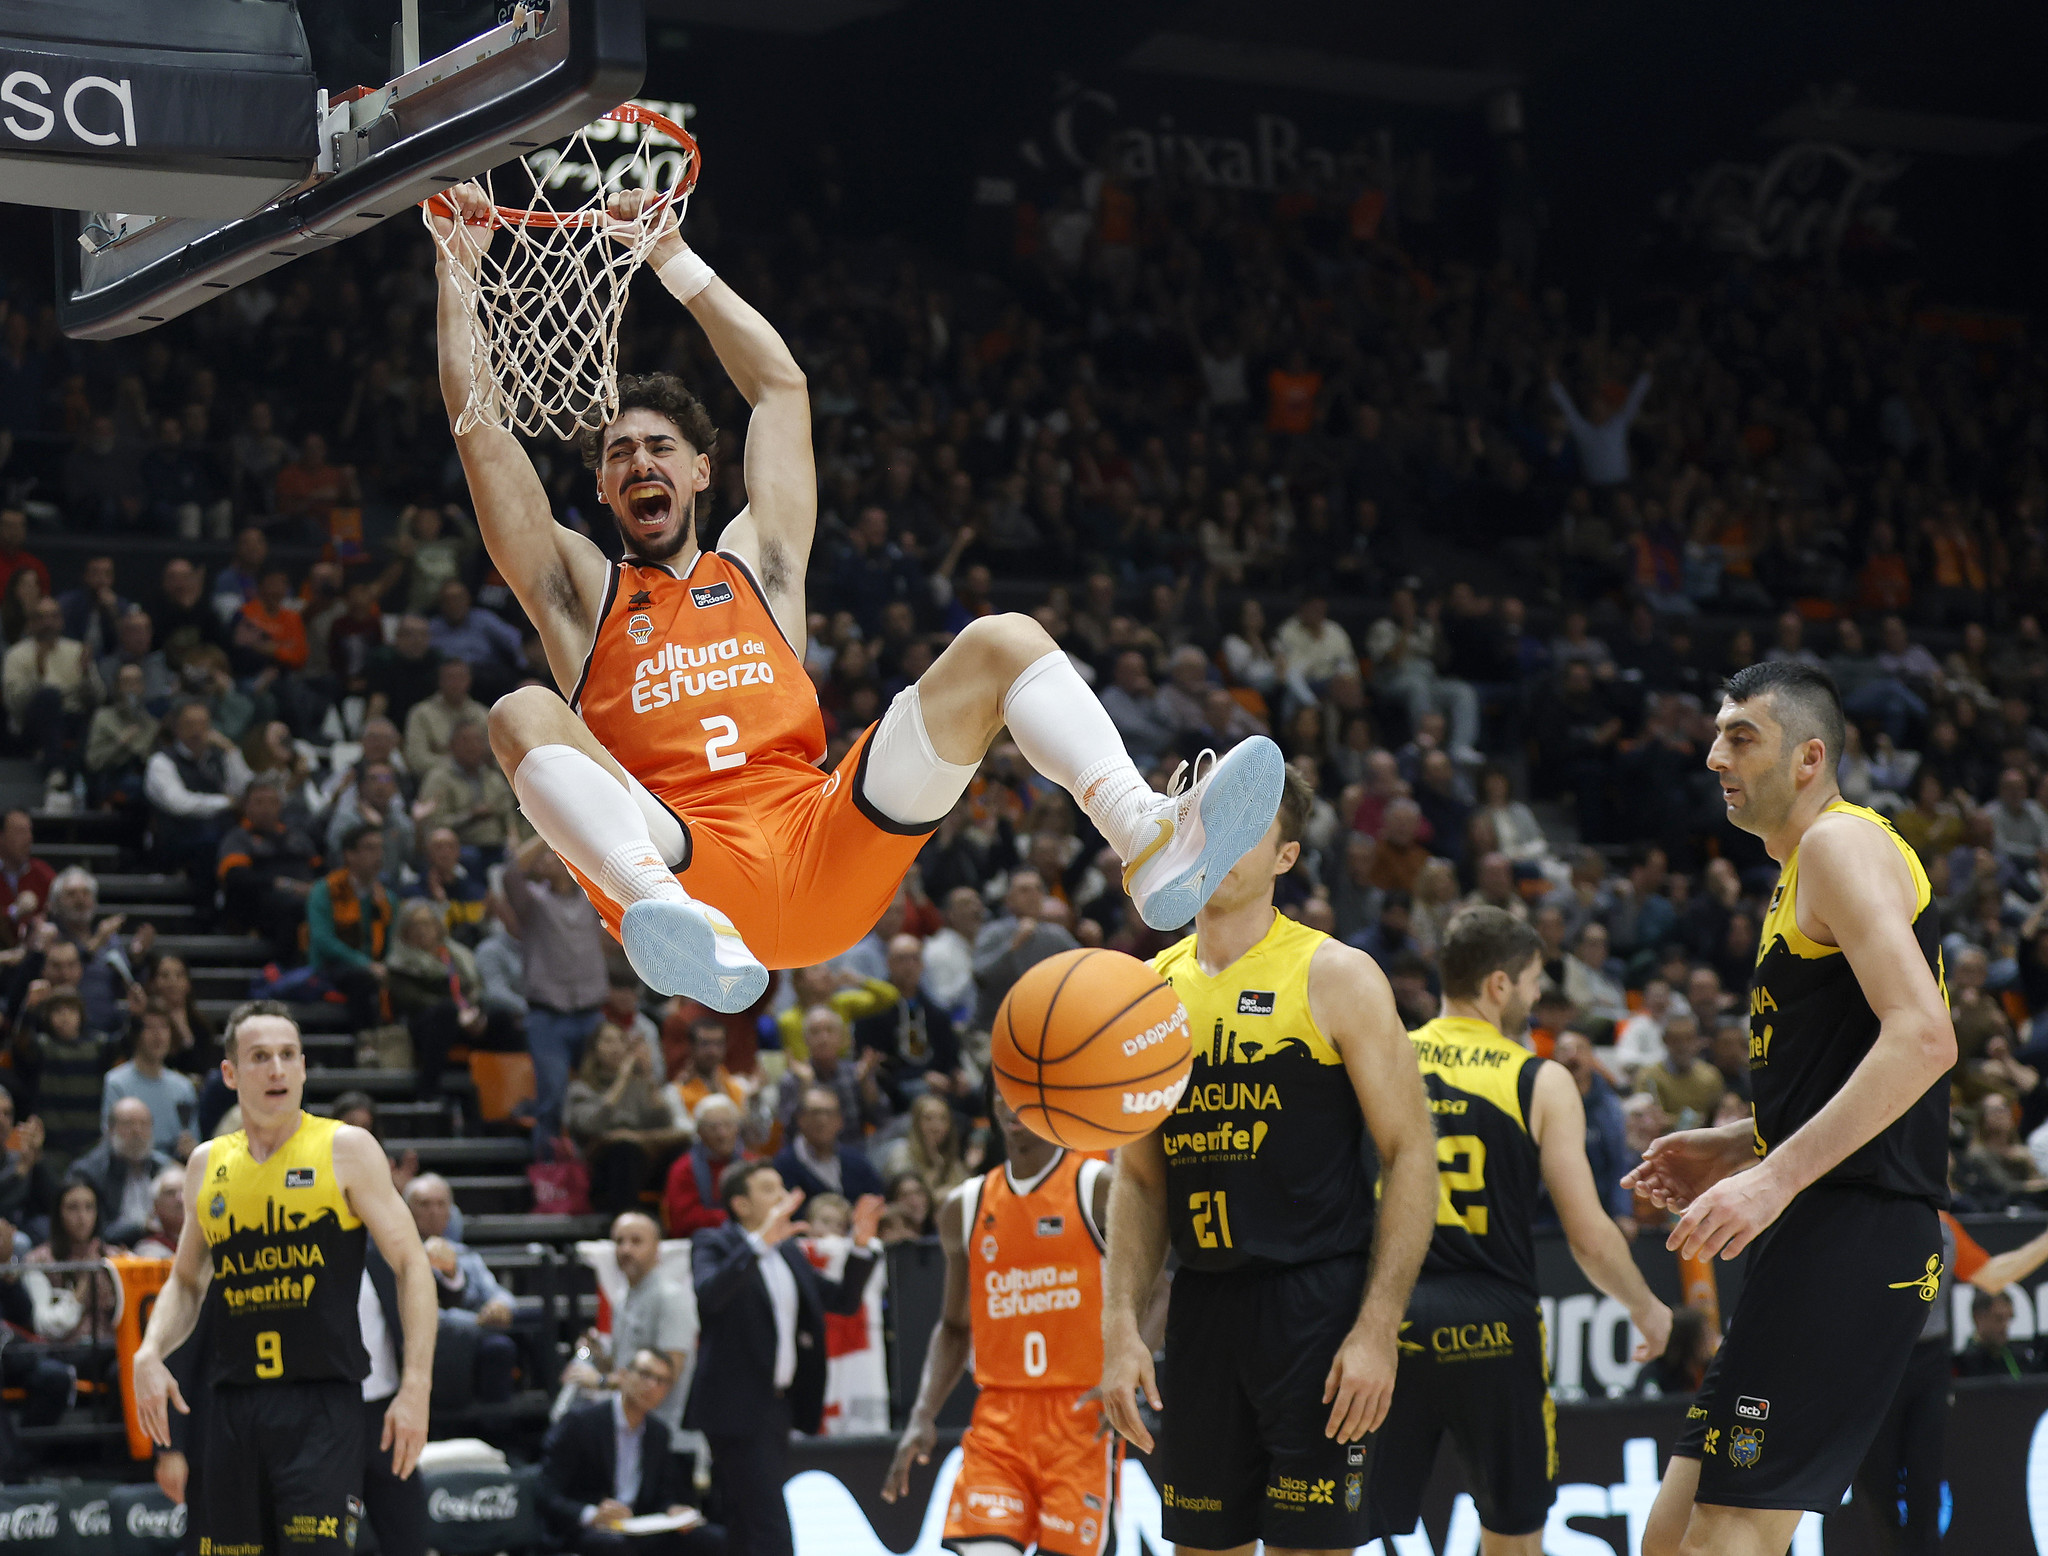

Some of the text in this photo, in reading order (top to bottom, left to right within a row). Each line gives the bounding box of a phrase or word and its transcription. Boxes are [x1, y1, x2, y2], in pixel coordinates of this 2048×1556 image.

[1, 71, 136, 147] sa
[698, 594, 731, 606] endesa
[742, 640, 766, 656] del
[631, 662, 774, 714] Esfuerzo
[700, 715, 747, 772] 2
[1176, 1083, 1282, 1114] LAGUNA
[1189, 1190, 1233, 1249] 21
[238, 1243, 326, 1275] LAGUNA
[985, 1265, 1057, 1295] Cultura
[987, 1287, 1081, 1320] Esfuerzo
[1432, 1321, 1513, 1353] CICAR
[255, 1330, 284, 1379] 9
[1024, 1330, 1048, 1378] 0
[1738, 1405, 1760, 1416] acb
[1279, 1475, 1308, 1492] Islas
